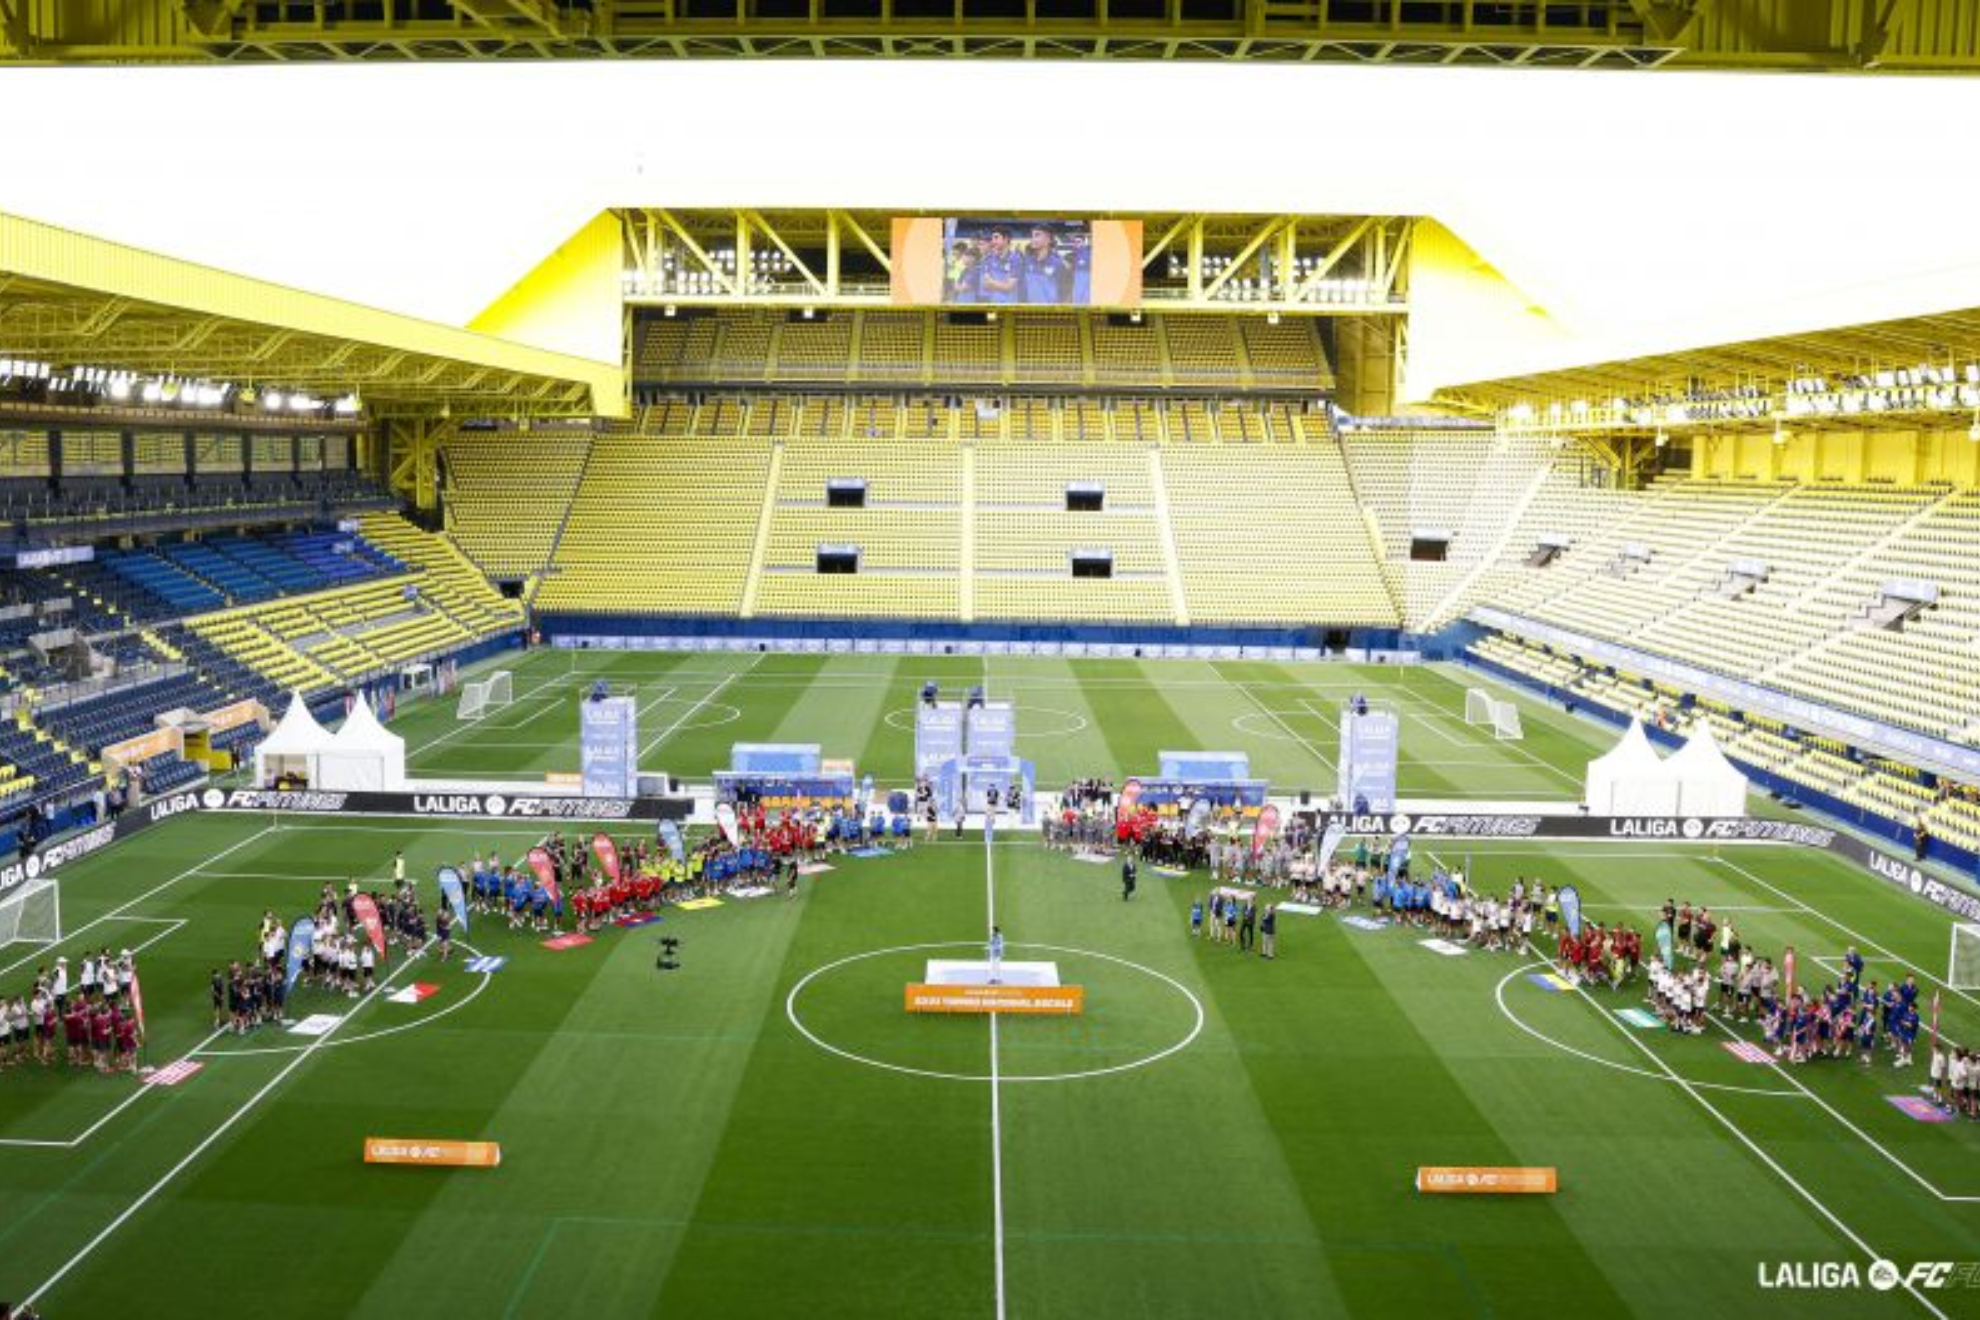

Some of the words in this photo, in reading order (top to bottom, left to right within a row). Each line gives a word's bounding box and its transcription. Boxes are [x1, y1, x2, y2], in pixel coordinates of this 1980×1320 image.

[151, 792, 200, 820] LALIGA
[413, 795, 481, 813] LALIGA
[1610, 819, 1679, 837] LALIGA
[1870, 850, 1908, 885] LALIGA
